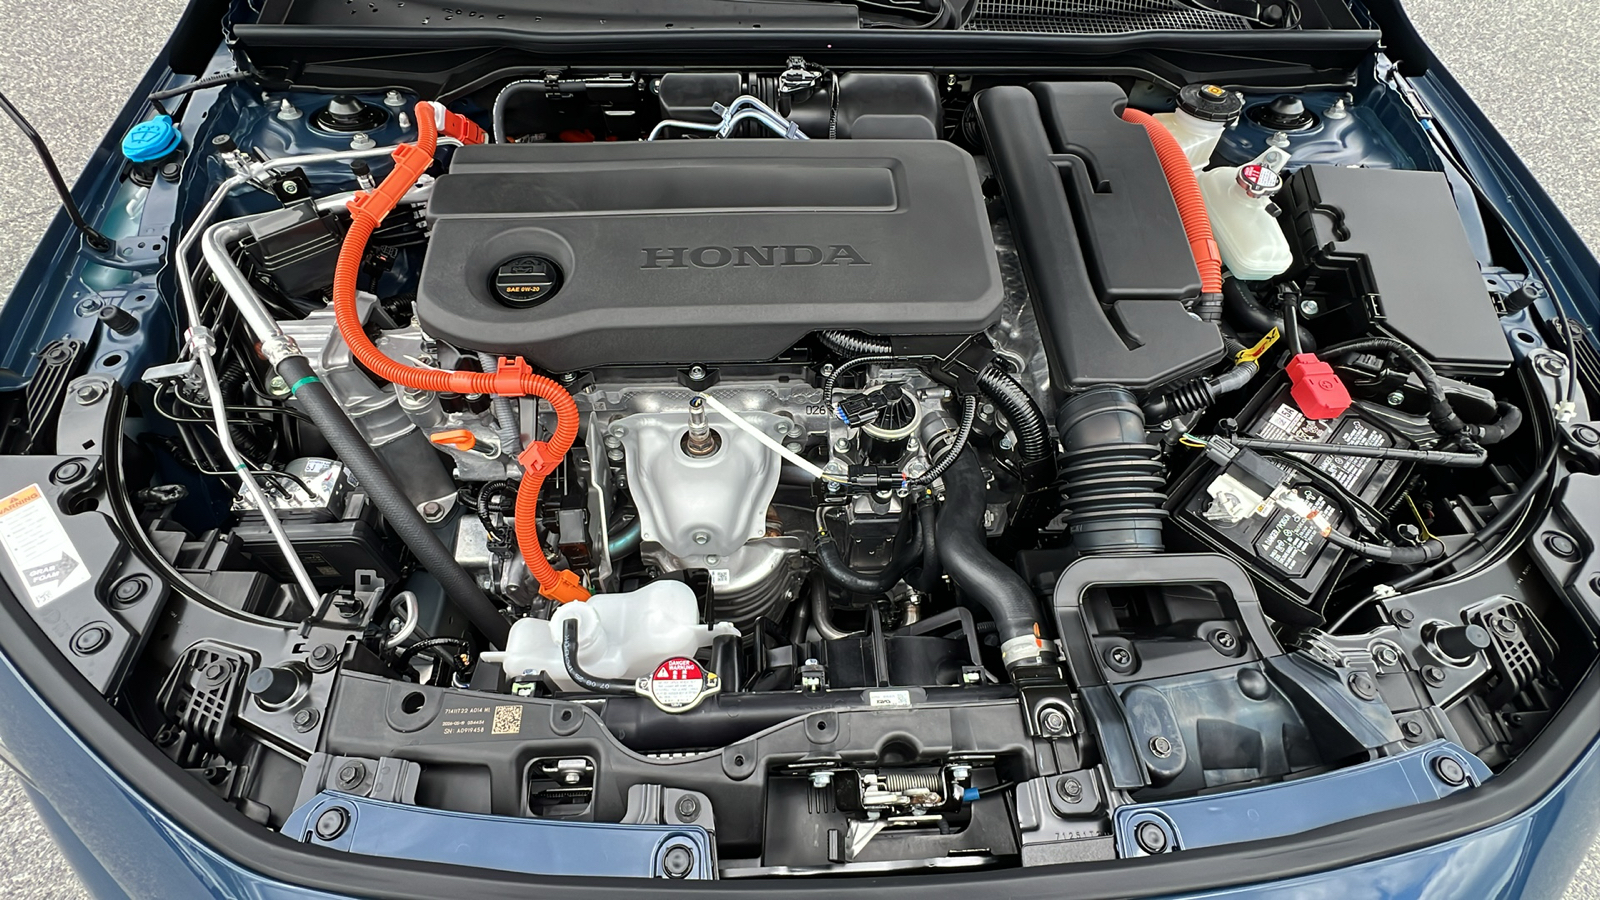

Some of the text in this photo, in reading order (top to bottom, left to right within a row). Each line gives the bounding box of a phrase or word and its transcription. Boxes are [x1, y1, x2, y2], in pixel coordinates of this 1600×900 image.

[640, 244, 872, 271] HONDA
[28, 565, 56, 577] GRAB
[32, 570, 60, 583] FOAM
